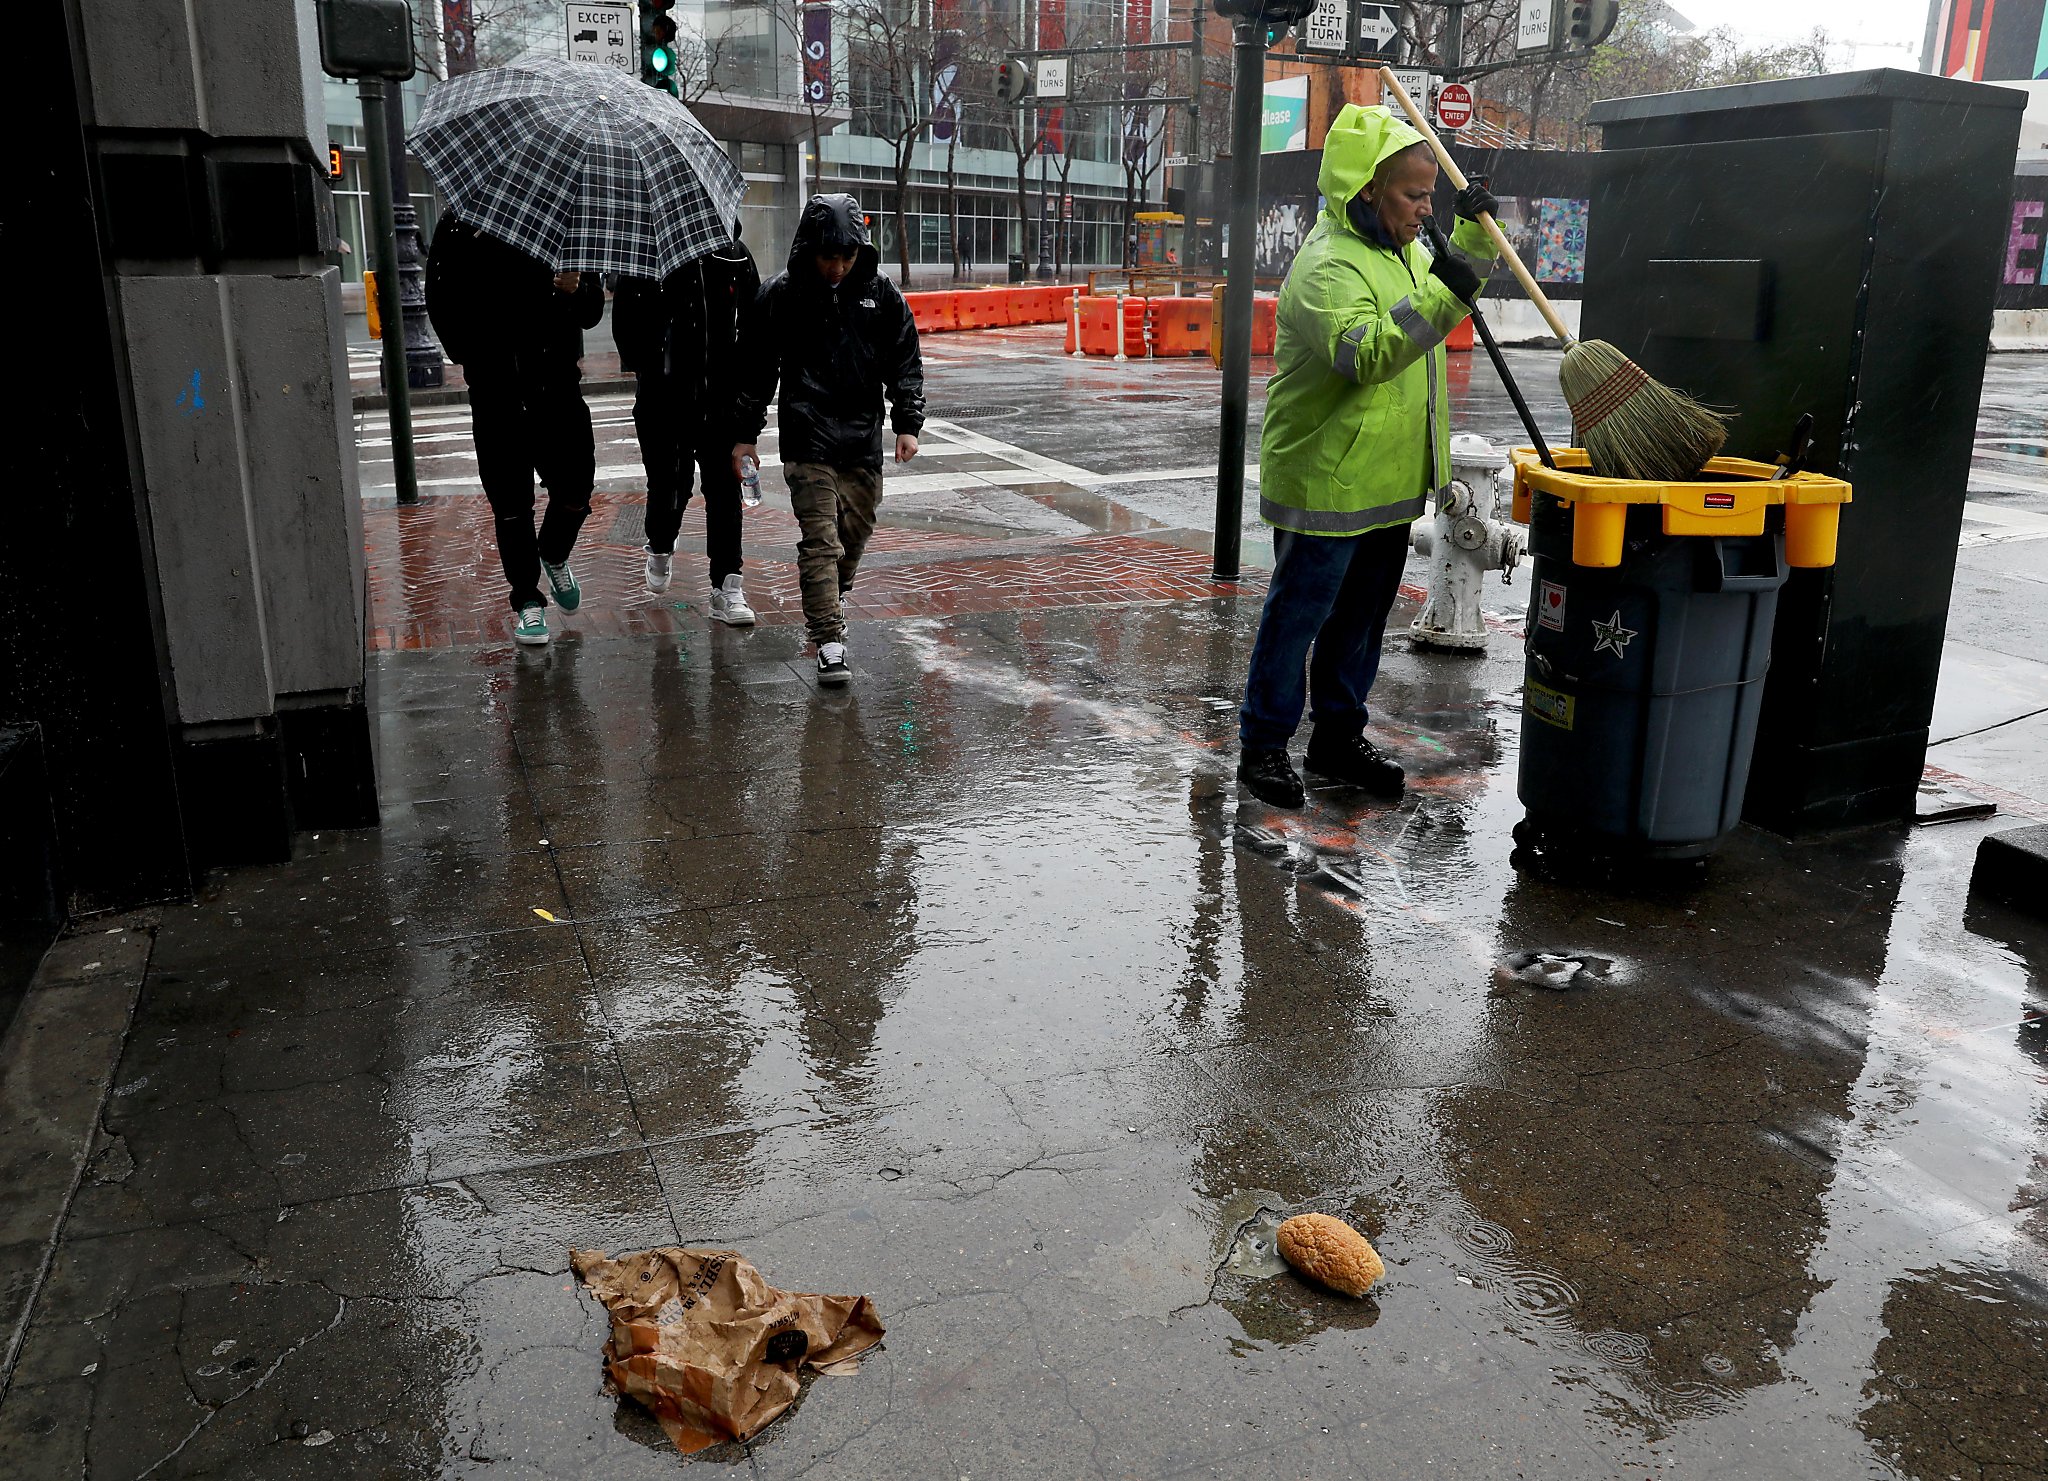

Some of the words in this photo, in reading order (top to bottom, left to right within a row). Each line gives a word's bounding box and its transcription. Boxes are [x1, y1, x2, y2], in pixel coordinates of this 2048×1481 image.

[1319, 2, 1336, 14] NO
[578, 12, 621, 24] EXCEPT
[1530, 9, 1541, 20] NO
[1312, 15, 1342, 28] LEFT
[1362, 25, 1376, 33] ONE
[1380, 26, 1394, 34] WAY
[1522, 22, 1547, 36] TURNS
[1311, 28, 1343, 41] TURN
[577, 54, 596, 62] TAXI
[1046, 69, 1057, 78] NO
[1040, 79, 1064, 87] TURNS
[1395, 75, 1421, 83] XCEPT
[1443, 92, 1453, 100] DO
[1456, 93, 1468, 101] NOT
[1444, 112, 1465, 120] ENTER
